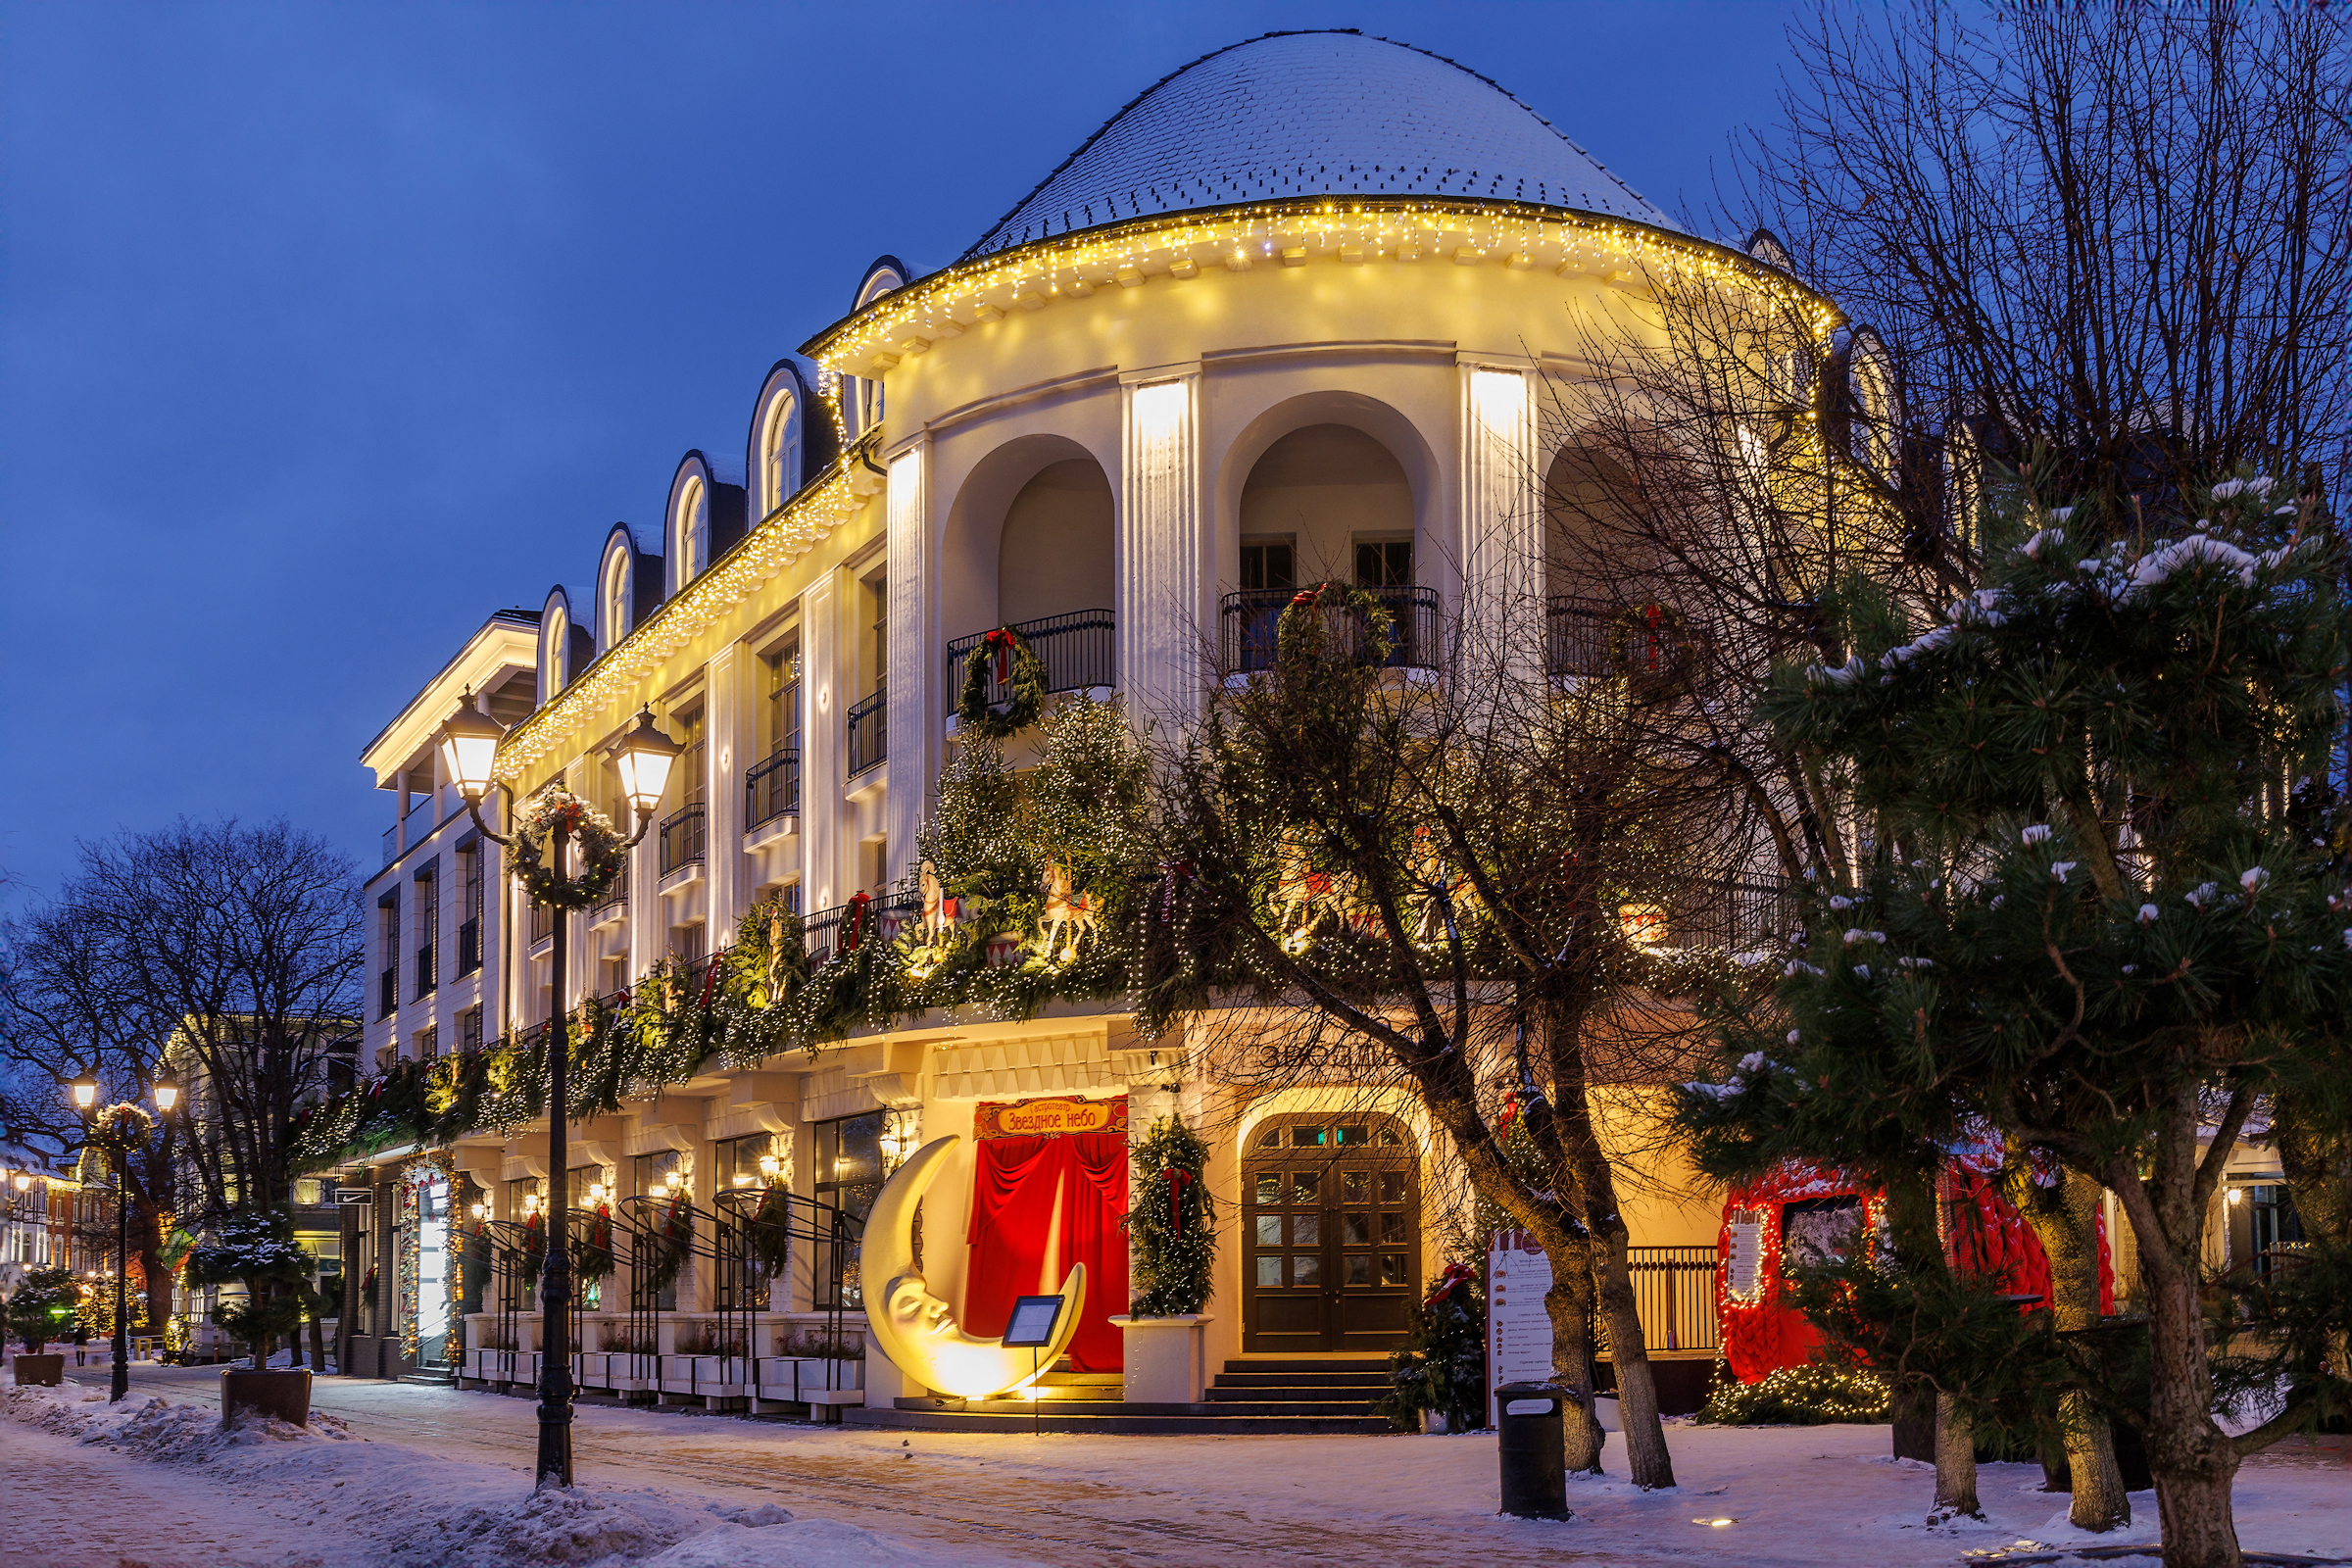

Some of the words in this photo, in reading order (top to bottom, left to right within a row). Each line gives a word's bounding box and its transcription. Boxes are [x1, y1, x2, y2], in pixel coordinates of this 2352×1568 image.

[1029, 1101, 1071, 1113] Гастротеатр
[1007, 1111, 1061, 1131] Звездное
[1066, 1107, 1096, 1127] небо
